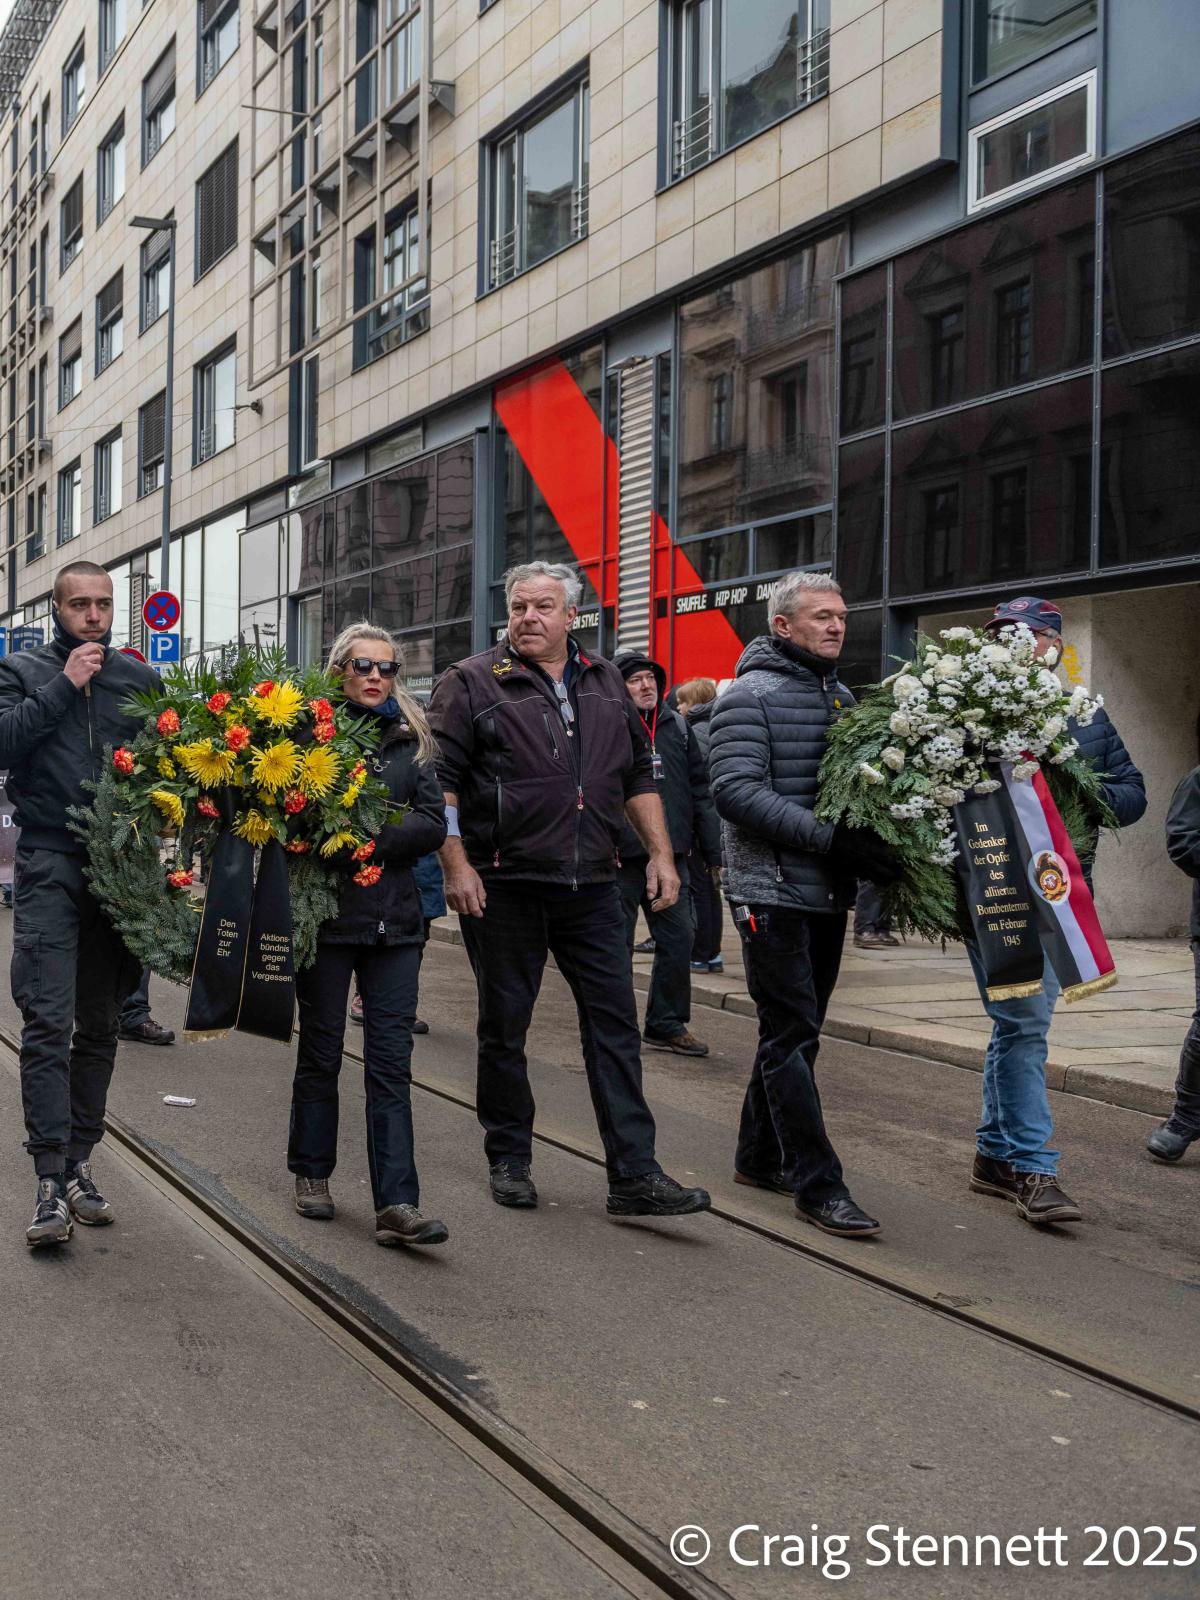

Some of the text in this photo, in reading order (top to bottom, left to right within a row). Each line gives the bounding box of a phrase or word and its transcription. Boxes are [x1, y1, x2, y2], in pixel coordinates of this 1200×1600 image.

[676, 594, 707, 613] SHUFFLE
[715, 590, 730, 607] HIP
[730, 587, 748, 605] HOP
[581, 612, 600, 629] STYLE
[157, 637, 173, 659] P
[975, 822, 988, 832] Im
[968, 836, 1008, 850] Gedenken
[973, 851, 1010, 866] der Opfer
[989, 870, 1005, 881] des
[984, 885, 1017, 898] alliierten
[976, 902, 1030, 916] Bombenterrors
[220, 919, 236, 929] Den
[987, 919, 1028, 932] im Februar
[217, 928, 239, 939] Toten
[260, 933, 290, 943] Aktions-
[1002, 935, 1021, 947] 1945
[217, 948, 231, 957] Ehr
[260, 942, 290, 953] bündnis
[262, 954, 286, 962] gegen
[266, 962, 280, 971] das
[252, 970, 293, 982] Vergessen
